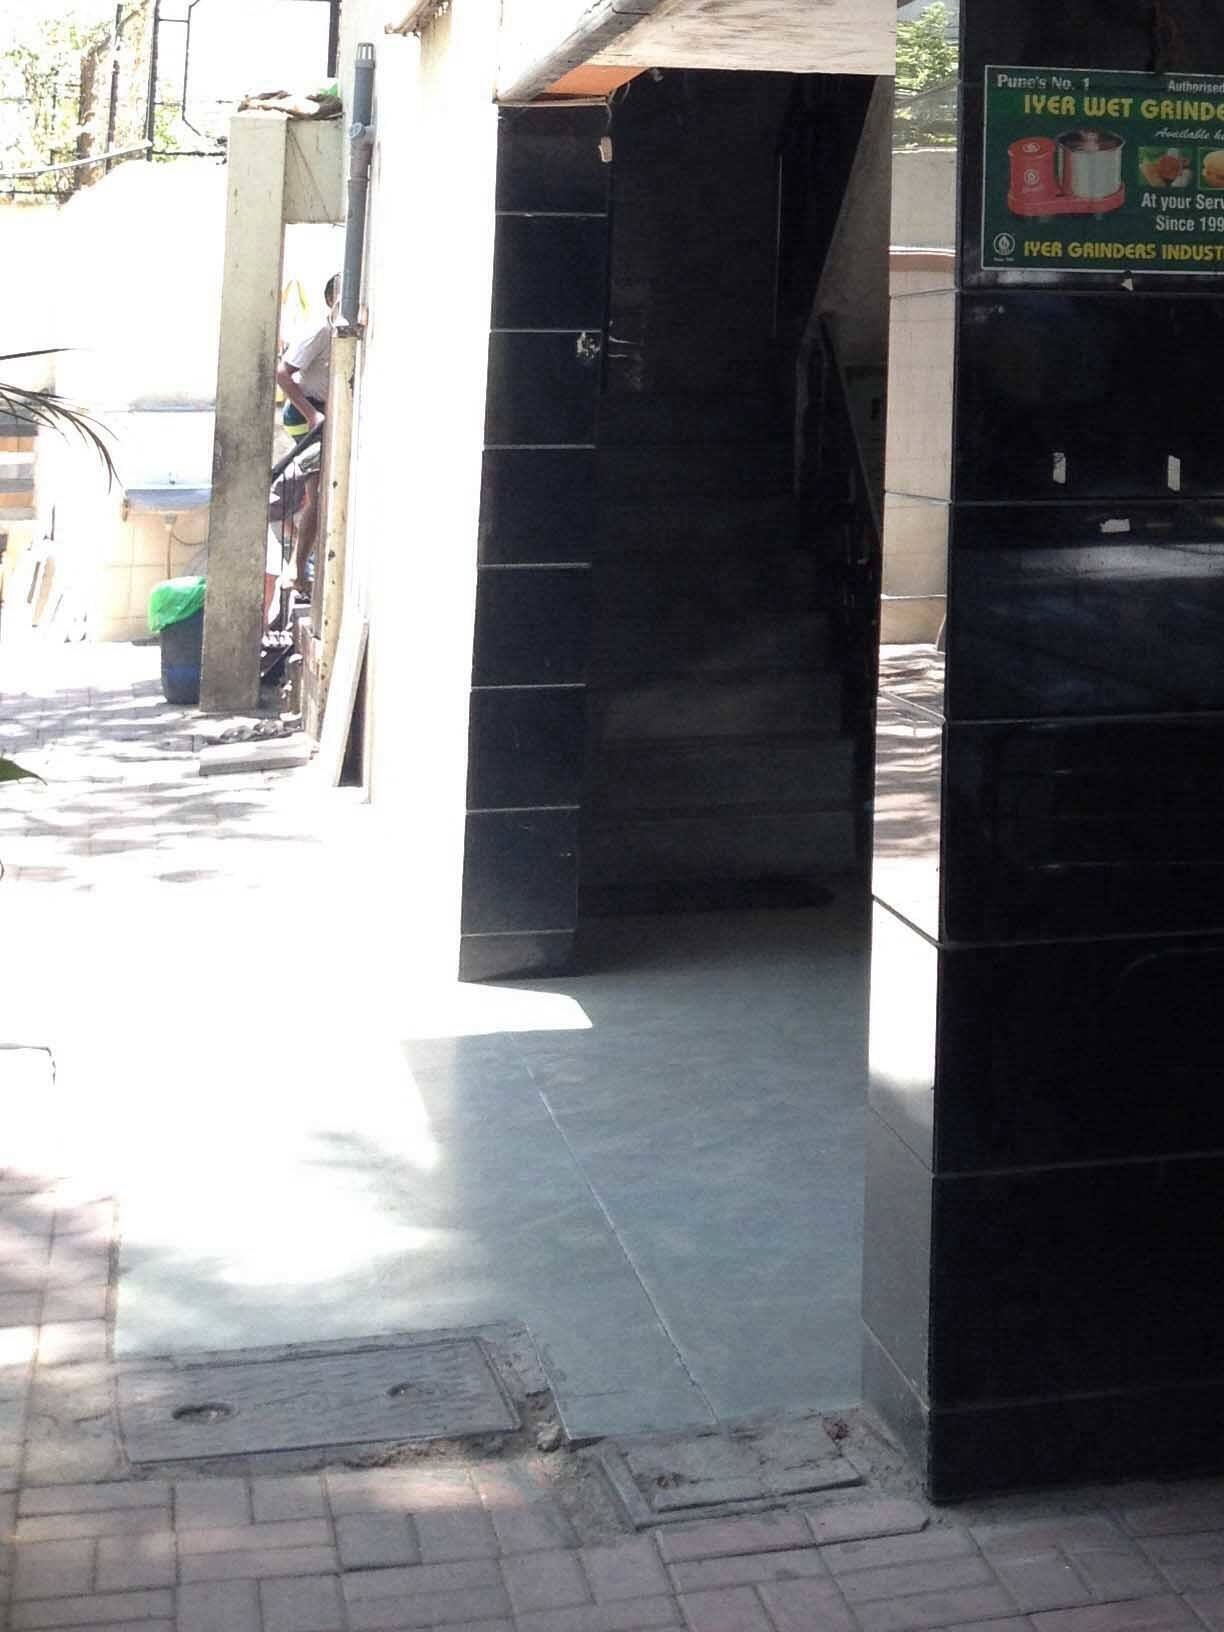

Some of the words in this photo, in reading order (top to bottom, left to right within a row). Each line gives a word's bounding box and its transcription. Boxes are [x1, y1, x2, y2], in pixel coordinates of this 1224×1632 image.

[997, 73, 1047, 90] Pune's
[1052, 76, 1075, 90] No.
[1082, 78, 1090, 91] 1
[1023, 94, 1076, 116] IYER
[1084, 96, 1133, 118] WET
[1141, 192, 1157, 208] At
[1160, 195, 1192, 212] your
[1155, 215, 1196, 232] Since
[1024, 240, 1063, 257] IYER
[1067, 241, 1157, 260] GRINDERS
